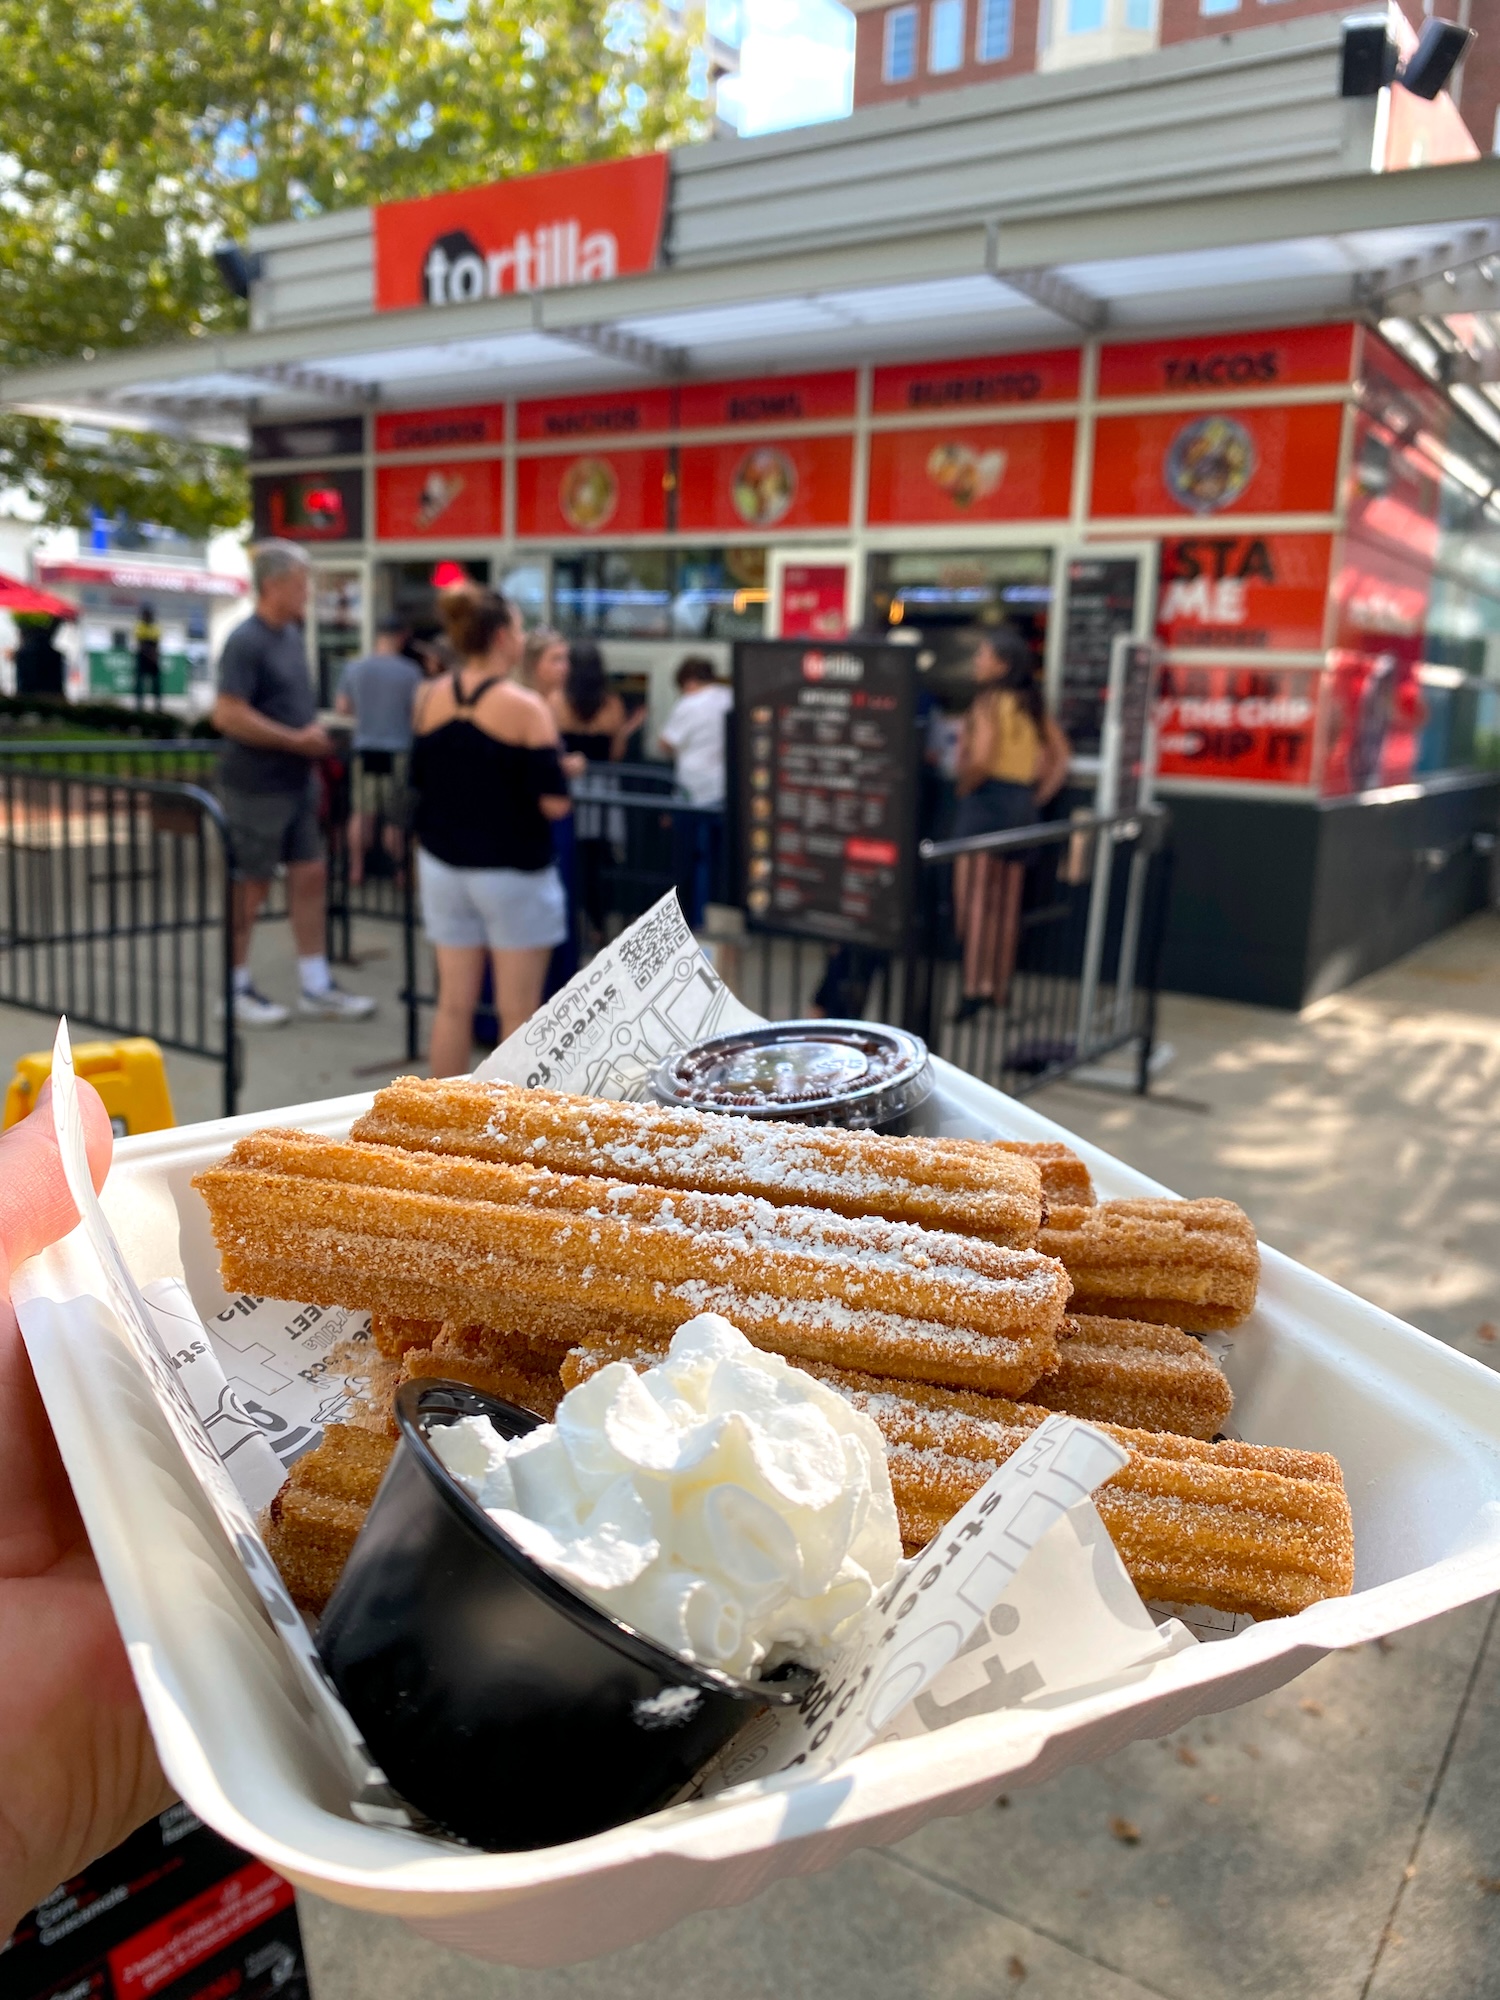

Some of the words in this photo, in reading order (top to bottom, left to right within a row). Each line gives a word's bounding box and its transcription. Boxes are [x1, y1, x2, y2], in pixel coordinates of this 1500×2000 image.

[424, 217, 617, 306] tortilla
[1163, 352, 1278, 387] TACOS
[525, 988, 588, 1057] US
[538, 959, 613, 1042] FOLLOW
[549, 984, 617, 1063] street
[301, 1306, 356, 1351] ortilla
[878, 1491, 1002, 1649] street
